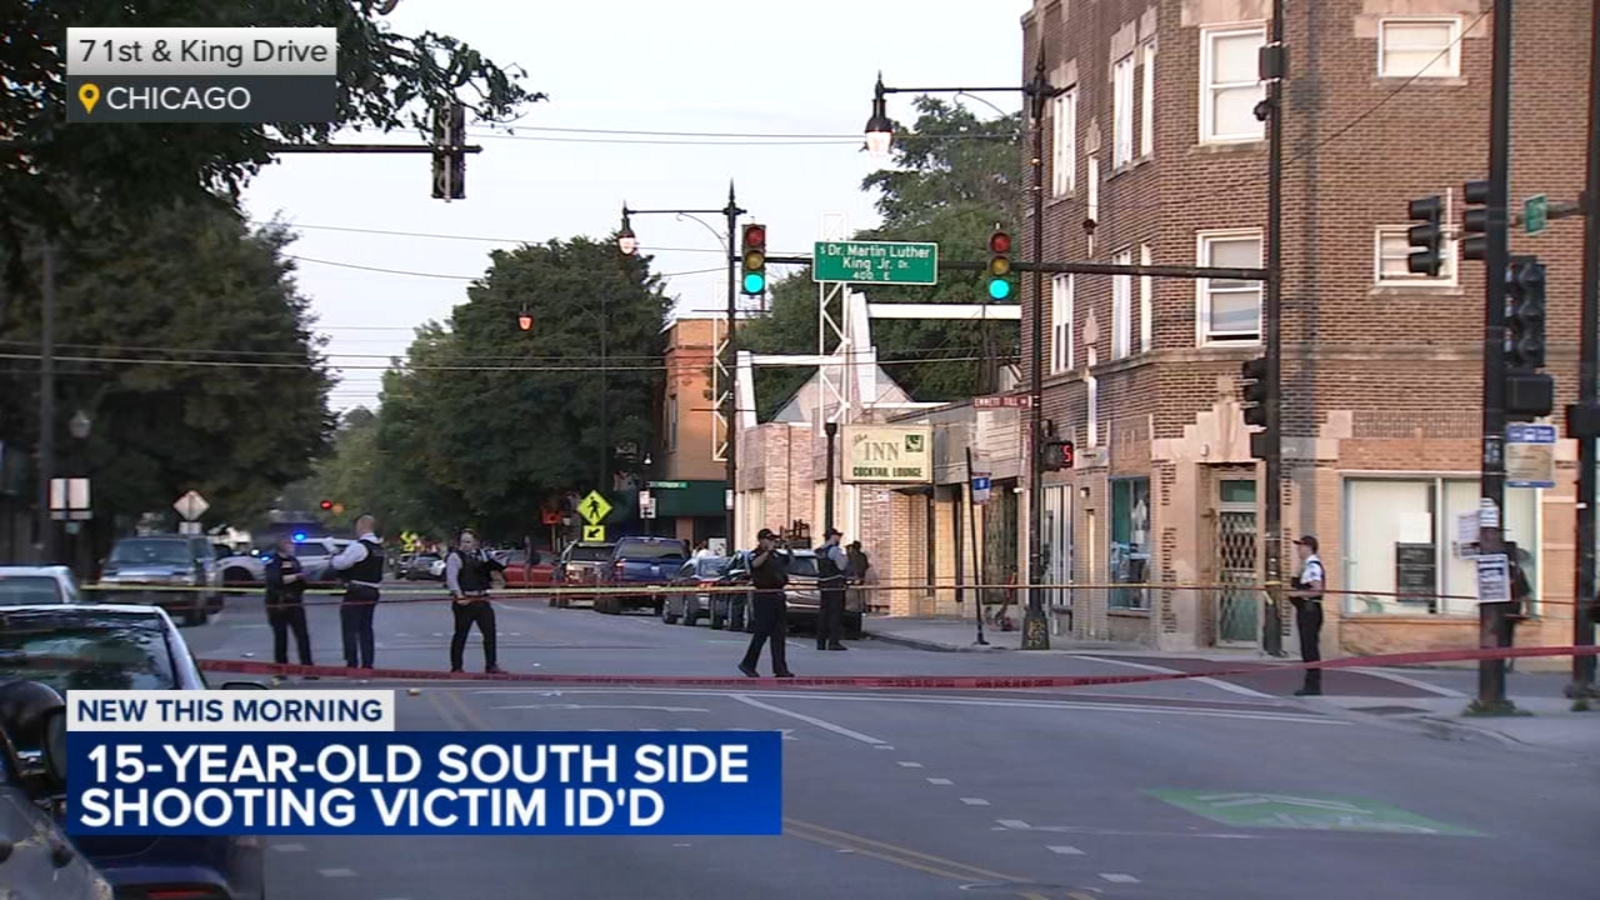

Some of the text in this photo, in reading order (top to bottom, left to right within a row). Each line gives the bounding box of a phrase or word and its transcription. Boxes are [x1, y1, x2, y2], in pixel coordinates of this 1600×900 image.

[828, 244, 844, 257] Dr.
[847, 244, 886, 258] Martin
[889, 245, 930, 259] Luther
[843, 256, 872, 270] King
[877, 257, 892, 270] Jr.
[883, 271, 891, 281] E
[865, 442, 899, 461] INN
[853, 467, 922, 477] COCKTAIL LOUNGE
